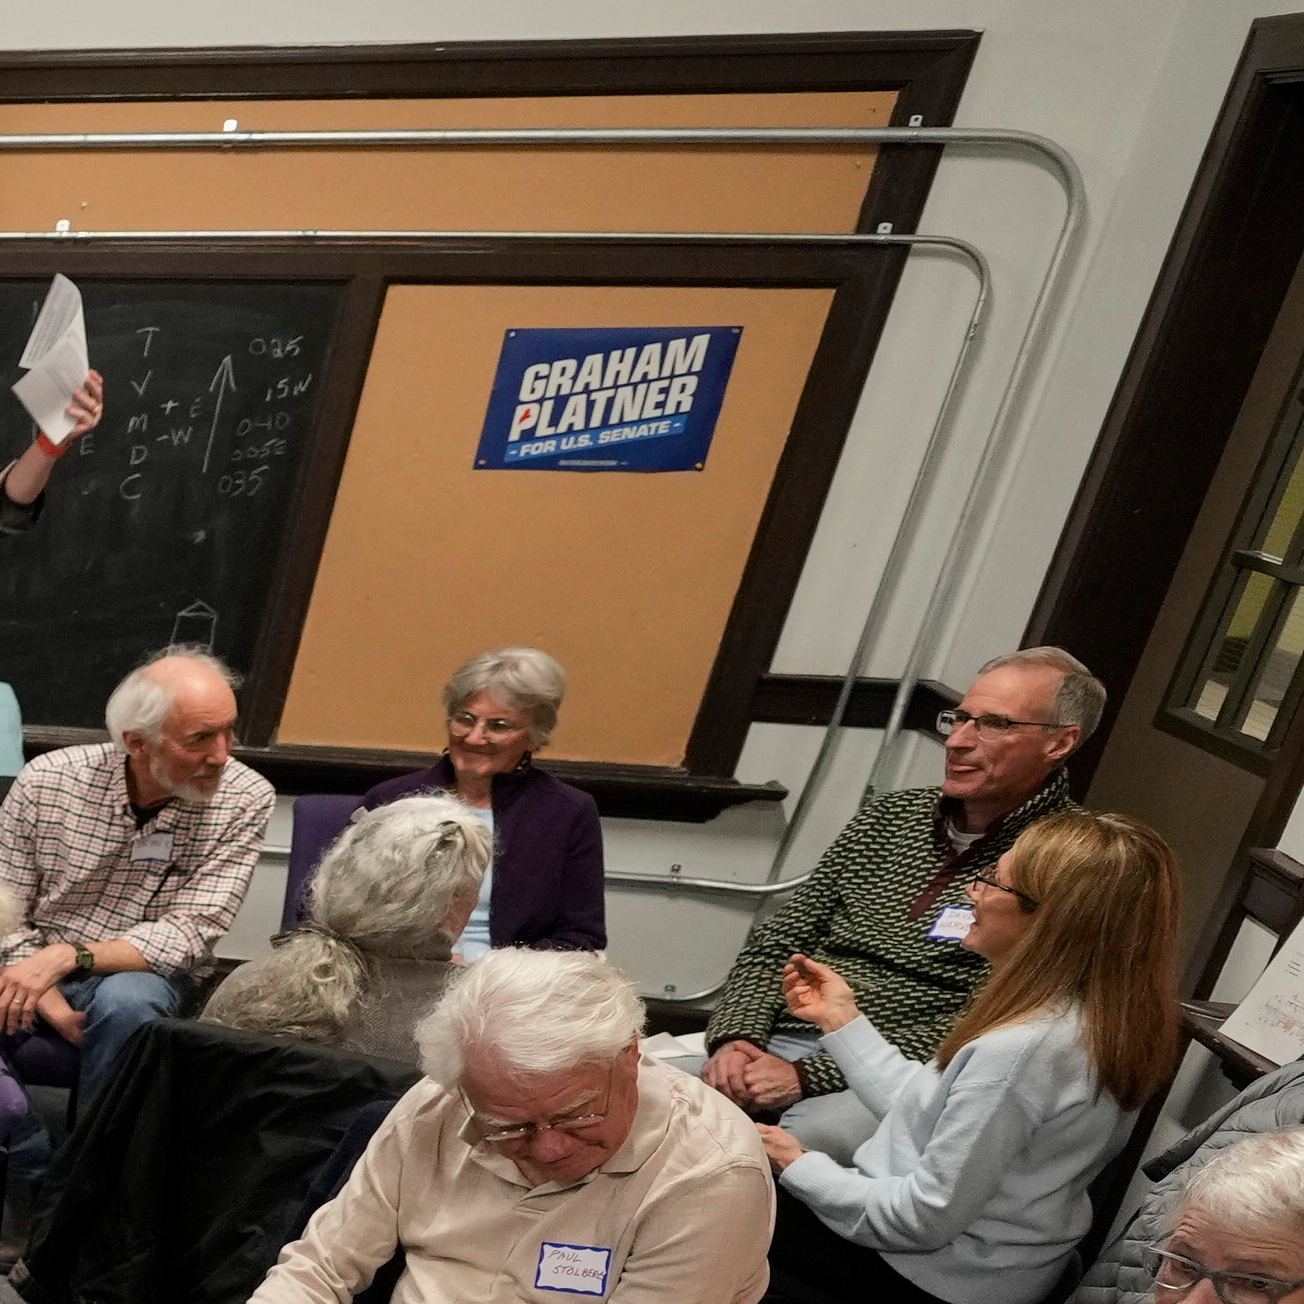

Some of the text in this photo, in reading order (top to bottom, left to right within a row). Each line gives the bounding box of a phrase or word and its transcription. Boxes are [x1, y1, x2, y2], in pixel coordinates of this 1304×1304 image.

[136, 326, 161, 358] T
[518, 333, 712, 403] GRAHAM
[127, 414, 149, 433] M
[507, 374, 700, 443] PLATNER
[519, 421, 670, 458] FOR U.S. SENATE
[119, 473, 143, 501] C
[218, 465, 270, 498] 035
[548, 1249, 582, 1263] PAUL
